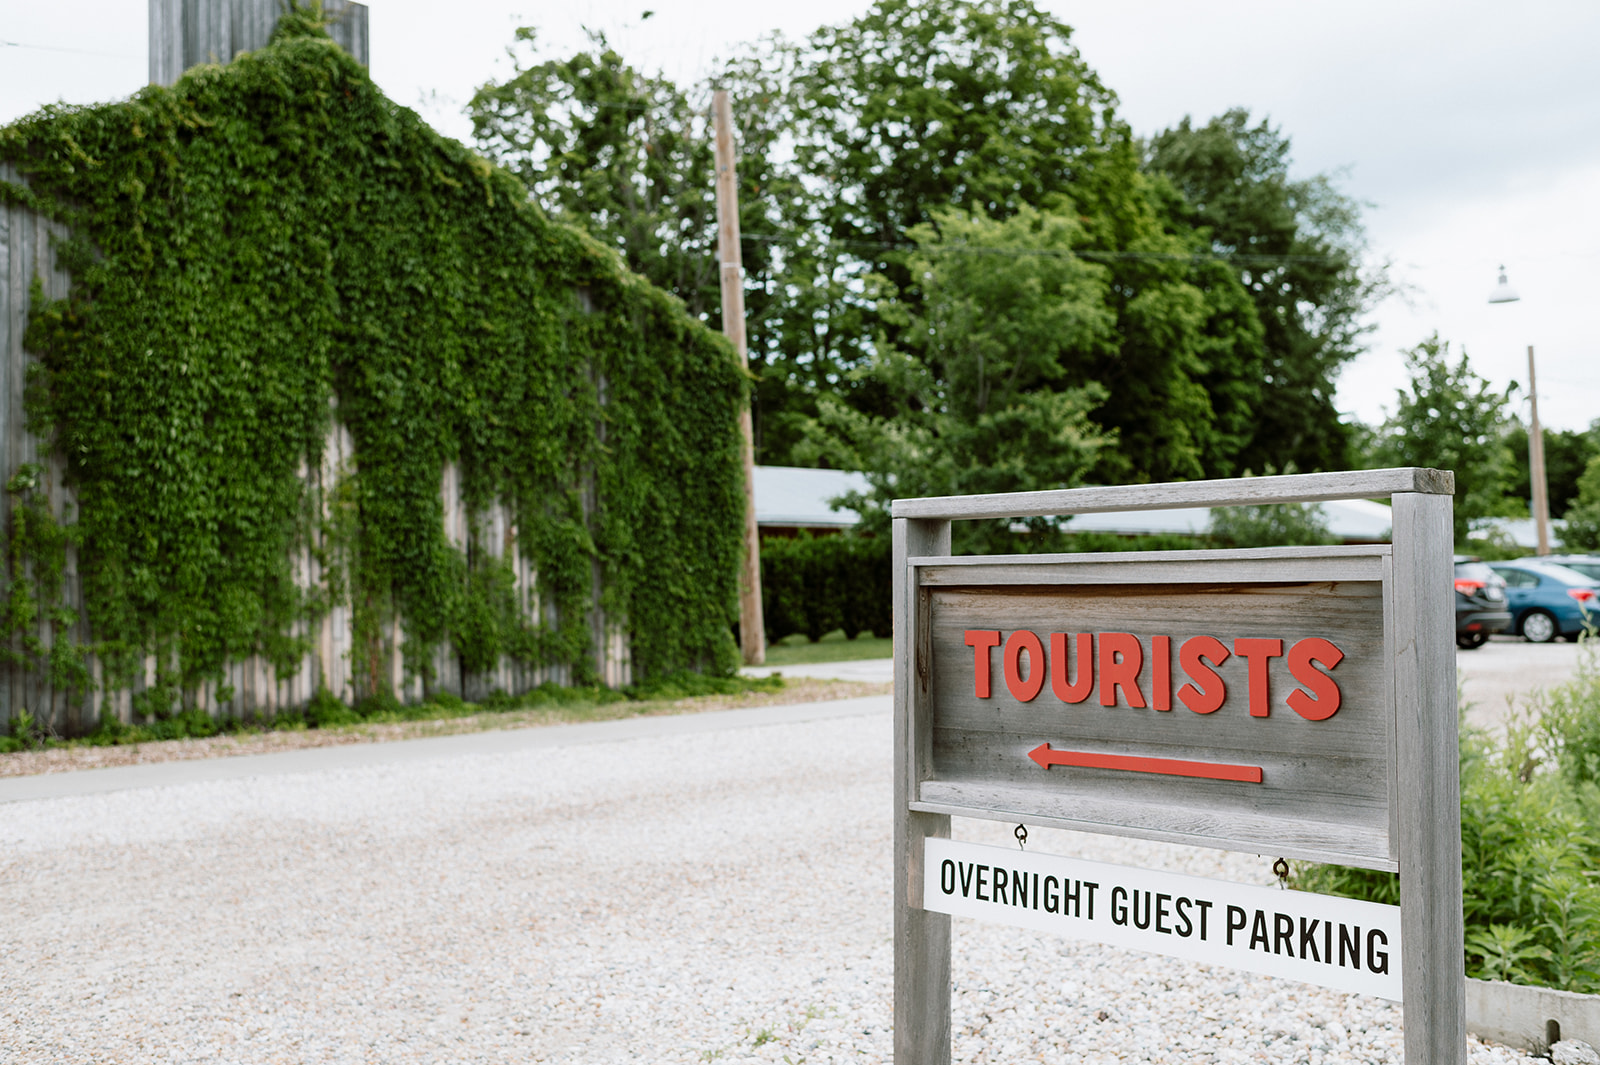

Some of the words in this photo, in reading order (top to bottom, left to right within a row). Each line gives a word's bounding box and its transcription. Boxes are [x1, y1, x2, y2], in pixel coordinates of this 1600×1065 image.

[964, 629, 1344, 721] TOURISTS
[941, 859, 1099, 921] OVERNIGHT
[1111, 886, 1213, 941] GUEST
[1226, 904, 1389, 976] PARKING
